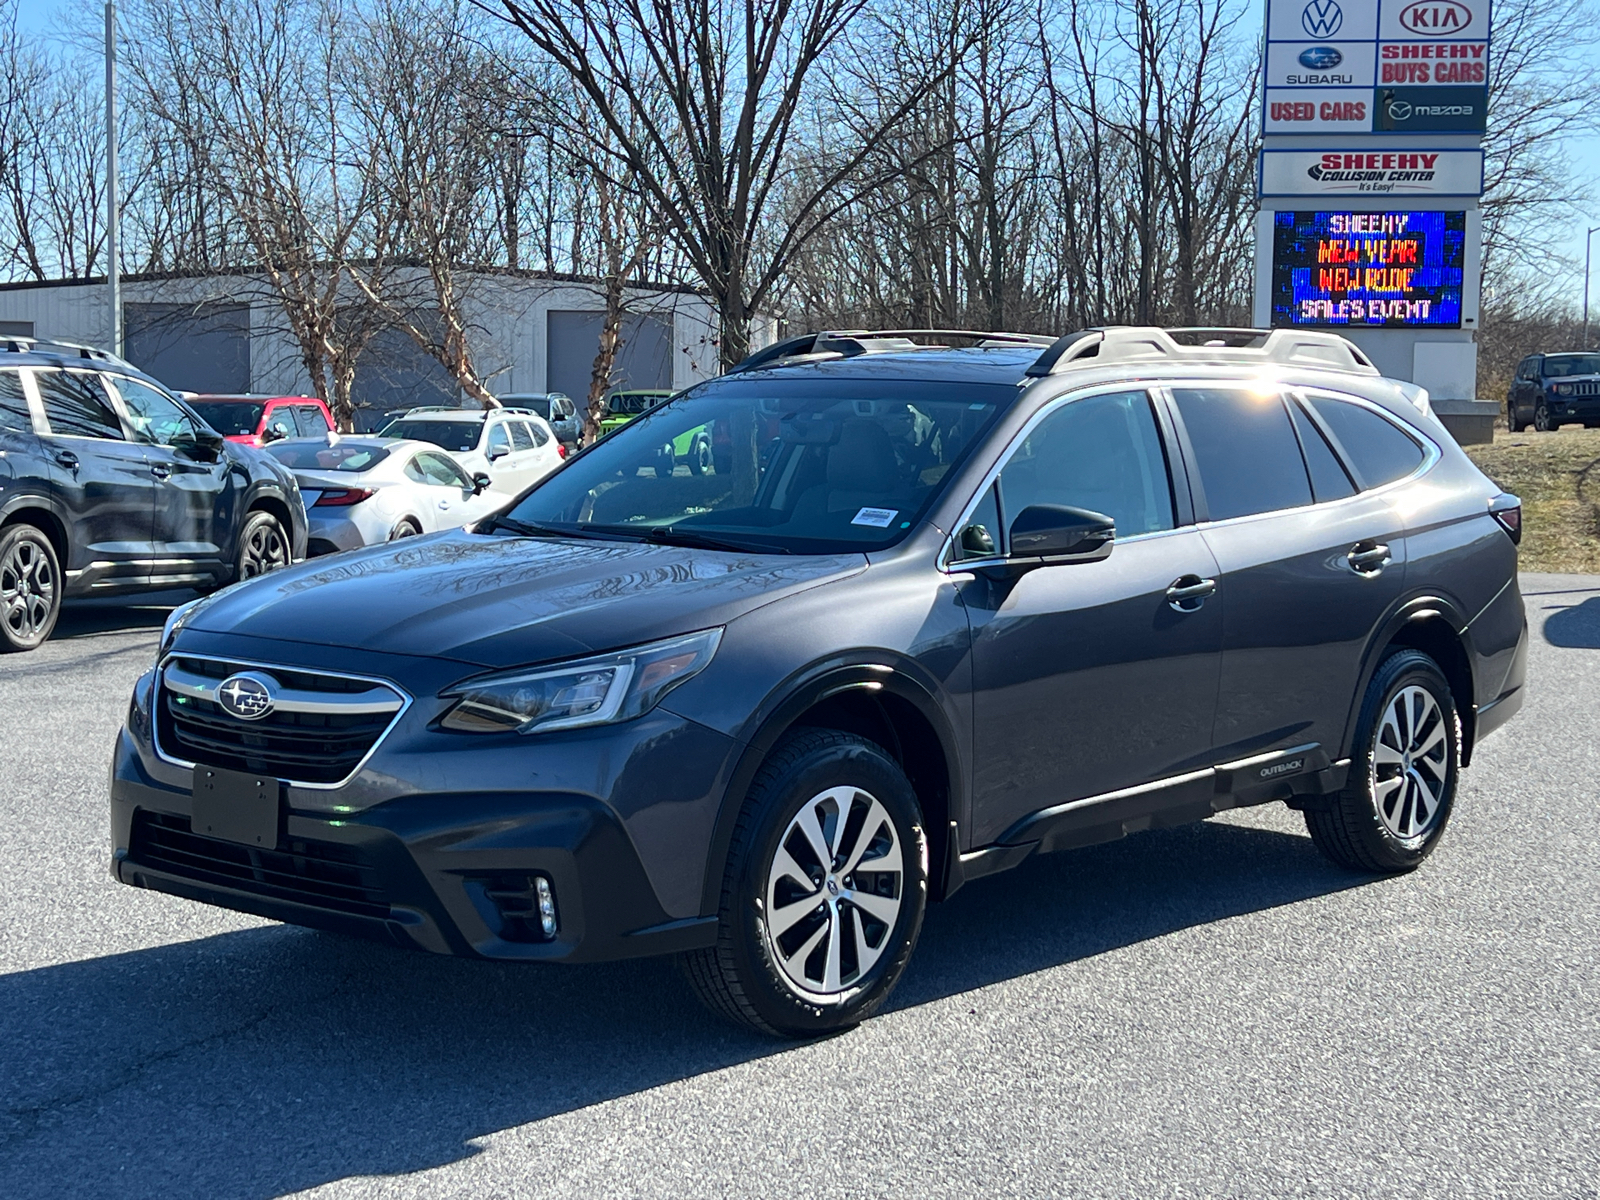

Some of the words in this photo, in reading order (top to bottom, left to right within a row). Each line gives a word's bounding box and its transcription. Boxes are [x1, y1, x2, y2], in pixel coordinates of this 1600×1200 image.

[1412, 8, 1459, 27] KIA
[1382, 45, 1486, 59] SHEEHY
[1286, 75, 1352, 84] SUBARU
[1382, 62, 1430, 83] BUYS
[1435, 62, 1484, 83] CARS
[1270, 102, 1315, 121] USED
[1320, 102, 1366, 121] CARS
[1321, 154, 1439, 169] SHEEHY
[1321, 171, 1384, 182] COLLISION
[1387, 171, 1435, 181] CENTER
[1359, 182, 1372, 190] It's
[1373, 182, 1395, 192] Easy!
[1330, 214, 1408, 233] SHEEHY
[1318, 239, 1359, 263] NEW
[1364, 239, 1417, 263] YEAR
[1319, 268, 1359, 292] NEW
[1301, 299, 1365, 319] SALES
[1368, 299, 1431, 319] EVENT
[1260, 760, 1302, 777] OUTBACK
